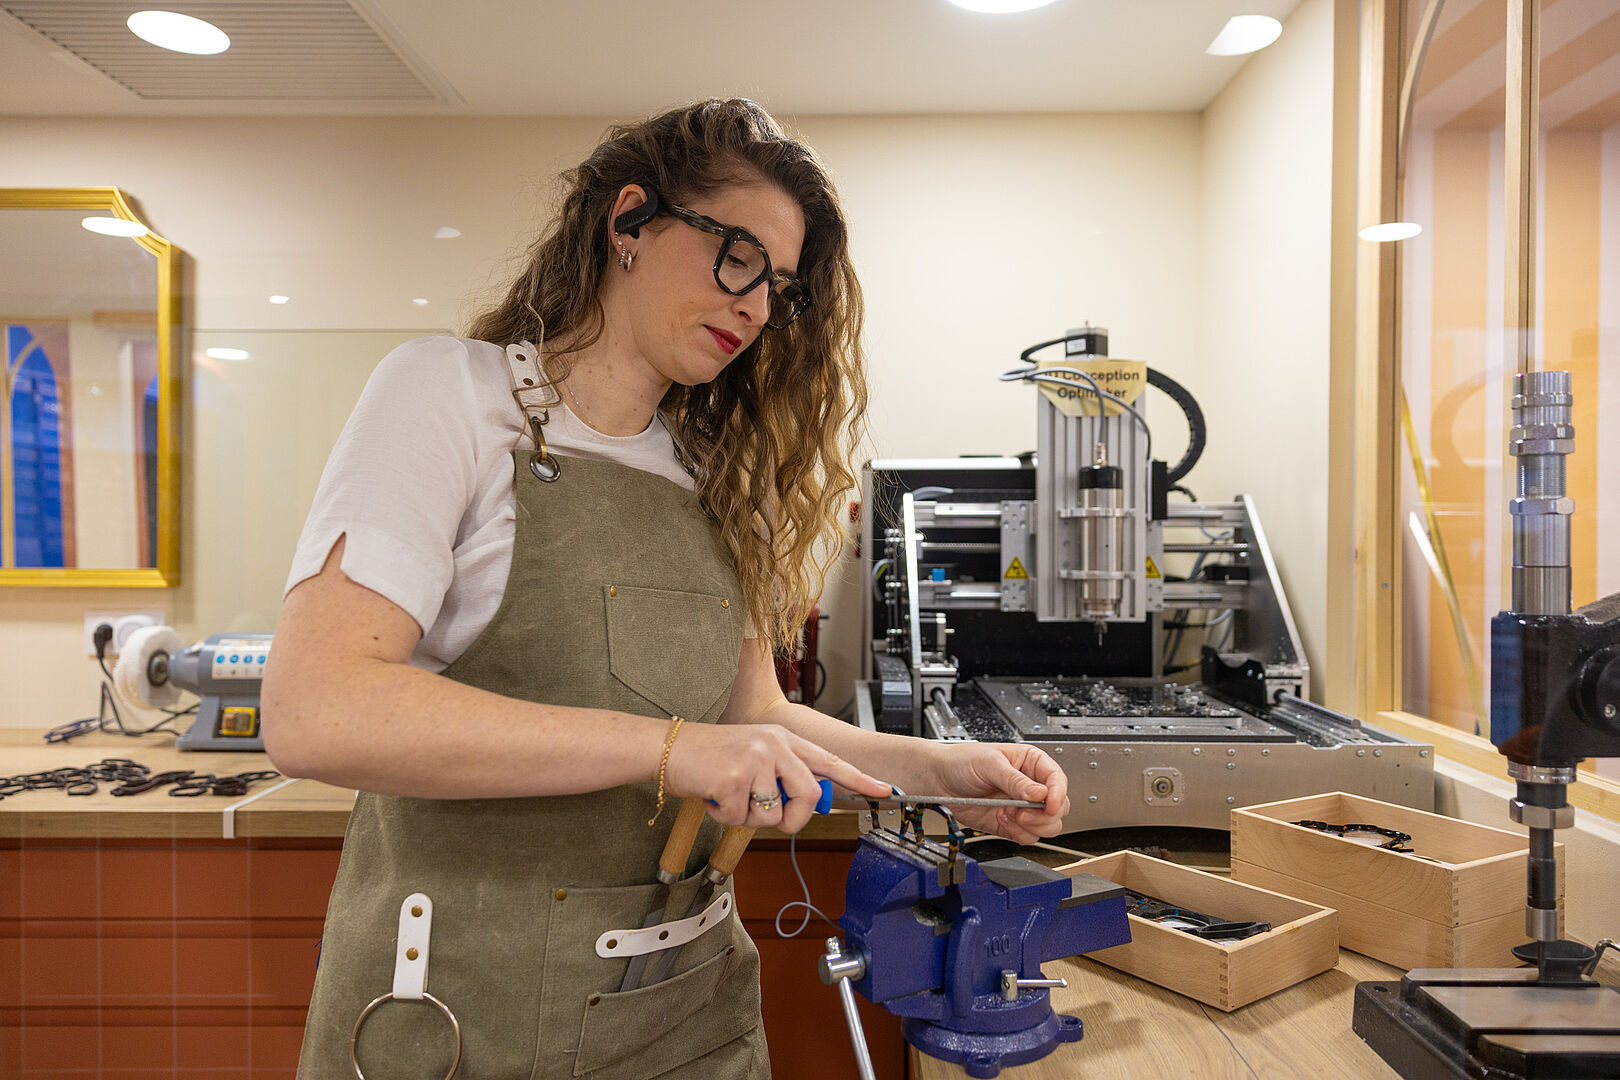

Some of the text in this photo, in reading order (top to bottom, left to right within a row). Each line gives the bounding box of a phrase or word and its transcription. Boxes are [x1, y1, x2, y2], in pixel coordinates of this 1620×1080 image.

[1063, 369, 1140, 382] Coception
[1057, 386, 1127, 399] Optimker
[984, 934, 1010, 958] 100
